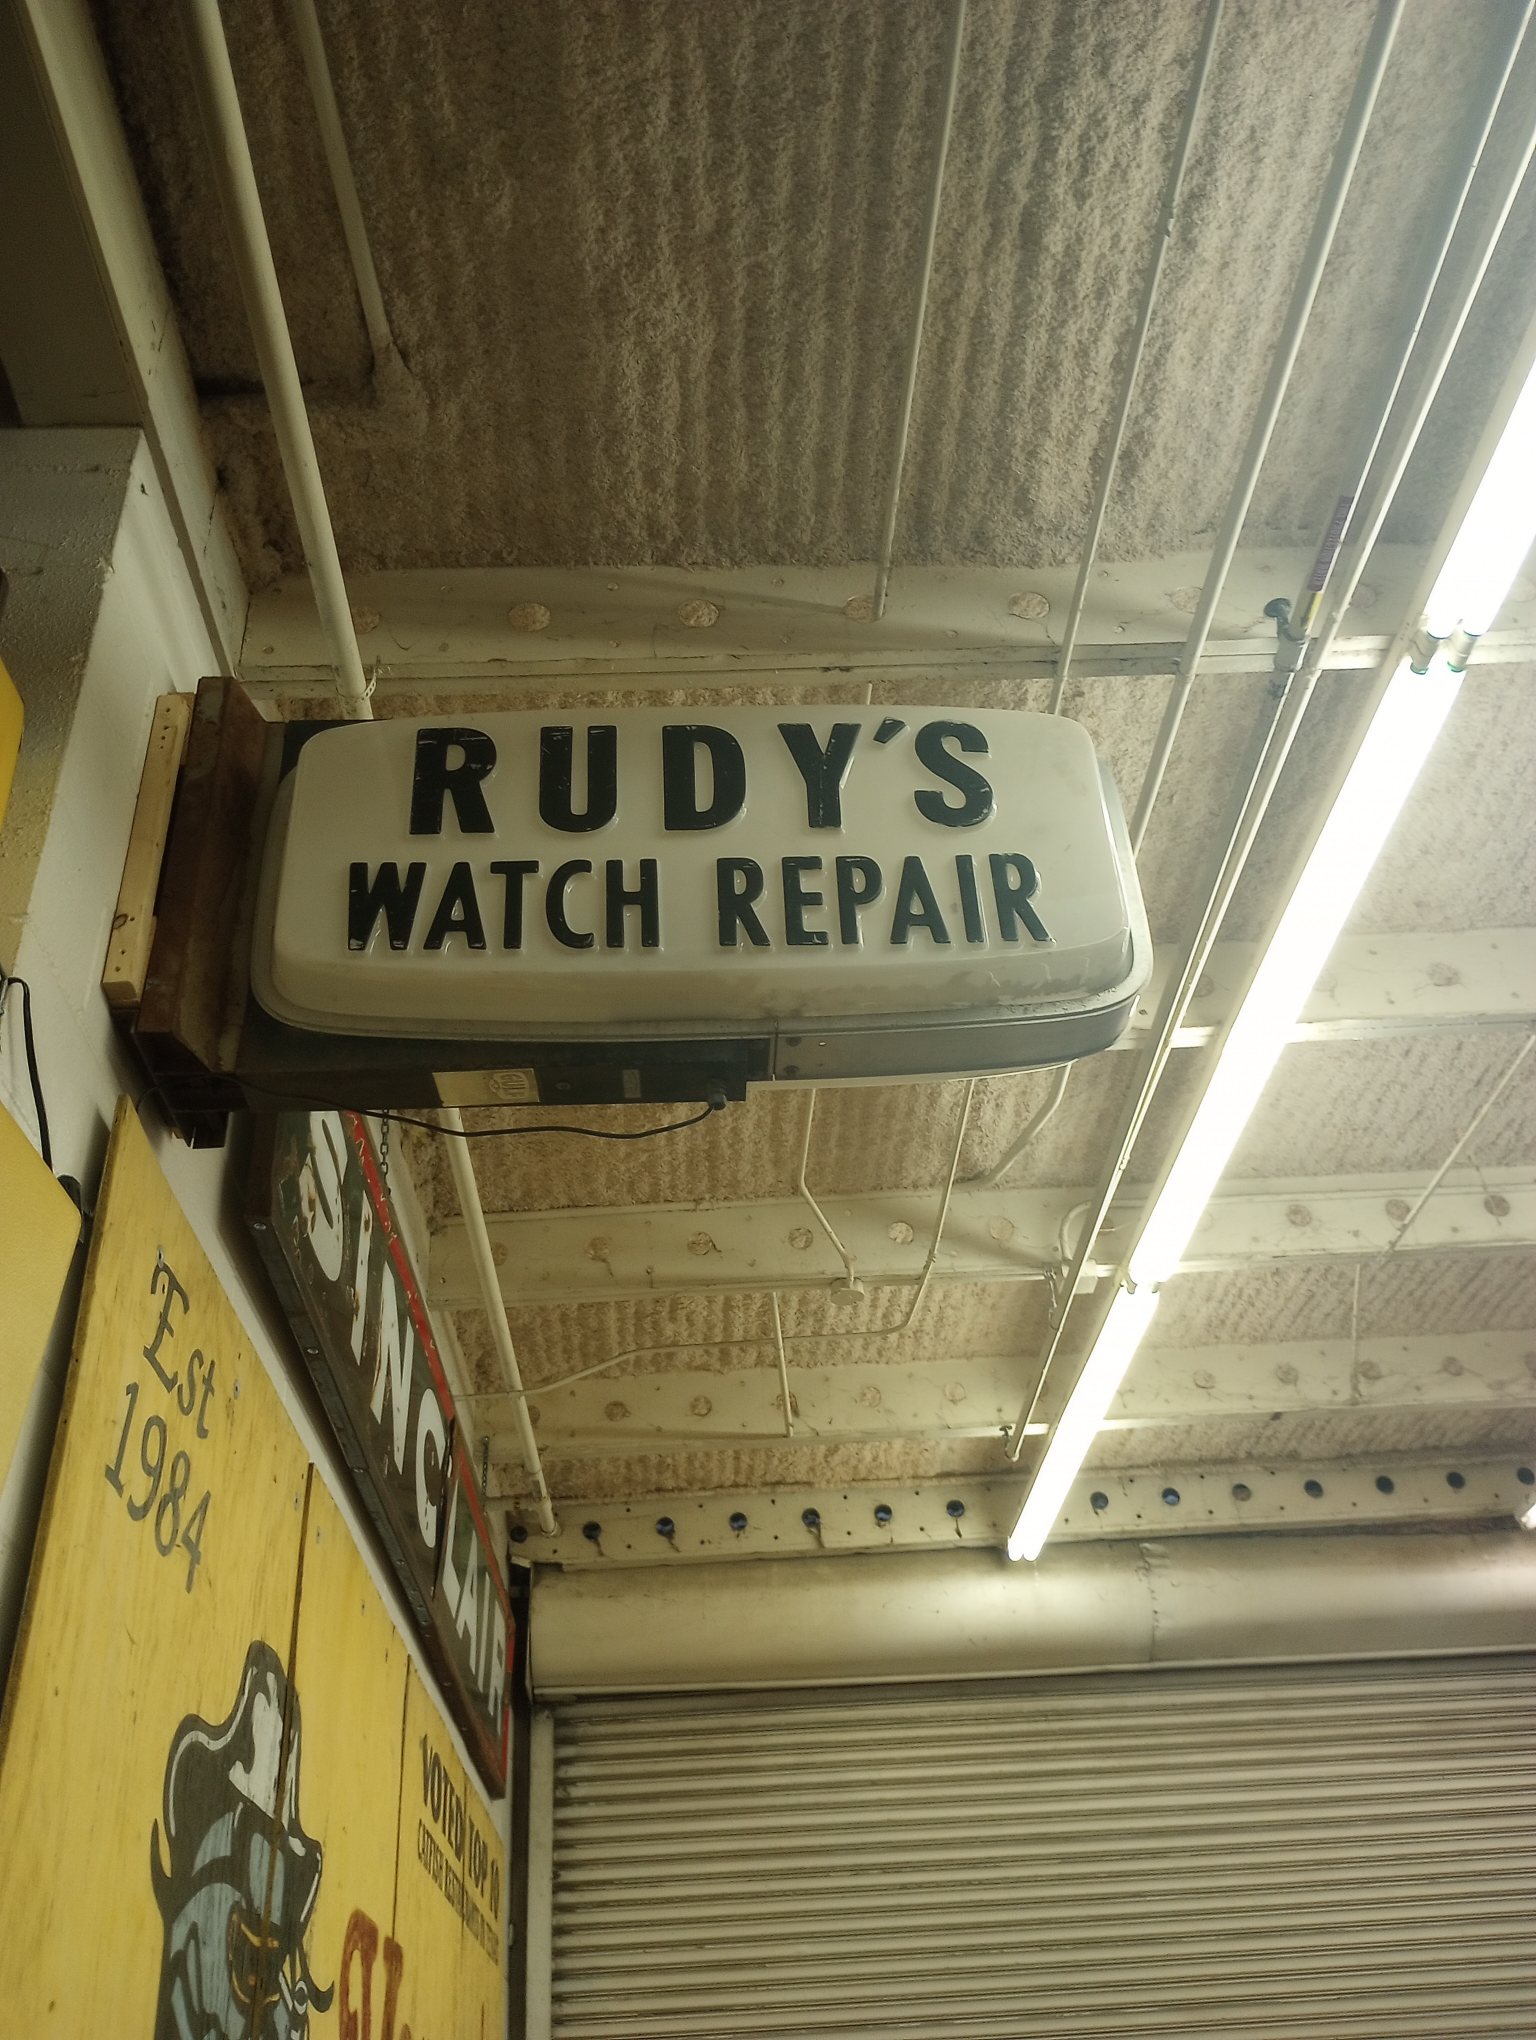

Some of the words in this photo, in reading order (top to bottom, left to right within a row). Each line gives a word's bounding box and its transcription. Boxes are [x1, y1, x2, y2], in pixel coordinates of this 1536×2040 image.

[408, 718, 997, 835] RUDY'S
[348, 859, 661, 951] WATCH
[718, 852, 1053, 947] REPAIR
[105, 1382, 211, 1594] 1984
[420, 1733, 463, 1862] VOTED
[468, 1815, 488, 1898] TOP
